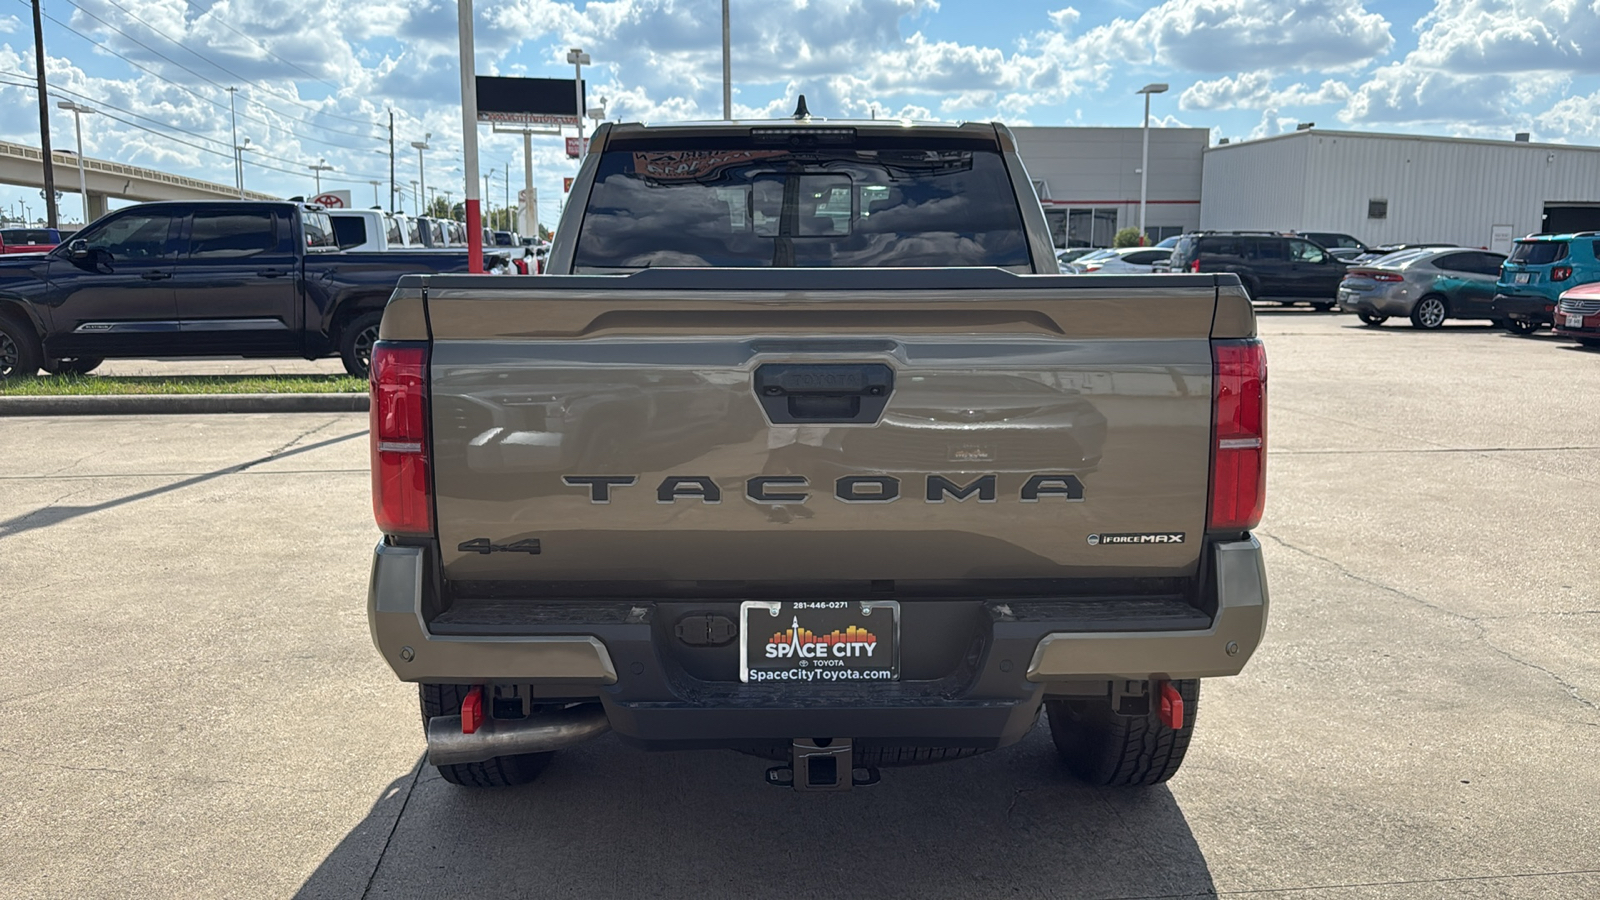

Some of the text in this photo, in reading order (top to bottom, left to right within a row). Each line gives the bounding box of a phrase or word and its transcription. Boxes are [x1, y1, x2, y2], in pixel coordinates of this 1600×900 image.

[792, 374, 859, 385] TOYOTA
[561, 473, 1087, 505] TACOMA
[793, 601, 849, 609] 281-446-0271
[765, 642, 877, 658] SPACE CITY
[749, 668, 891, 682] SpaceCityToyota.com
